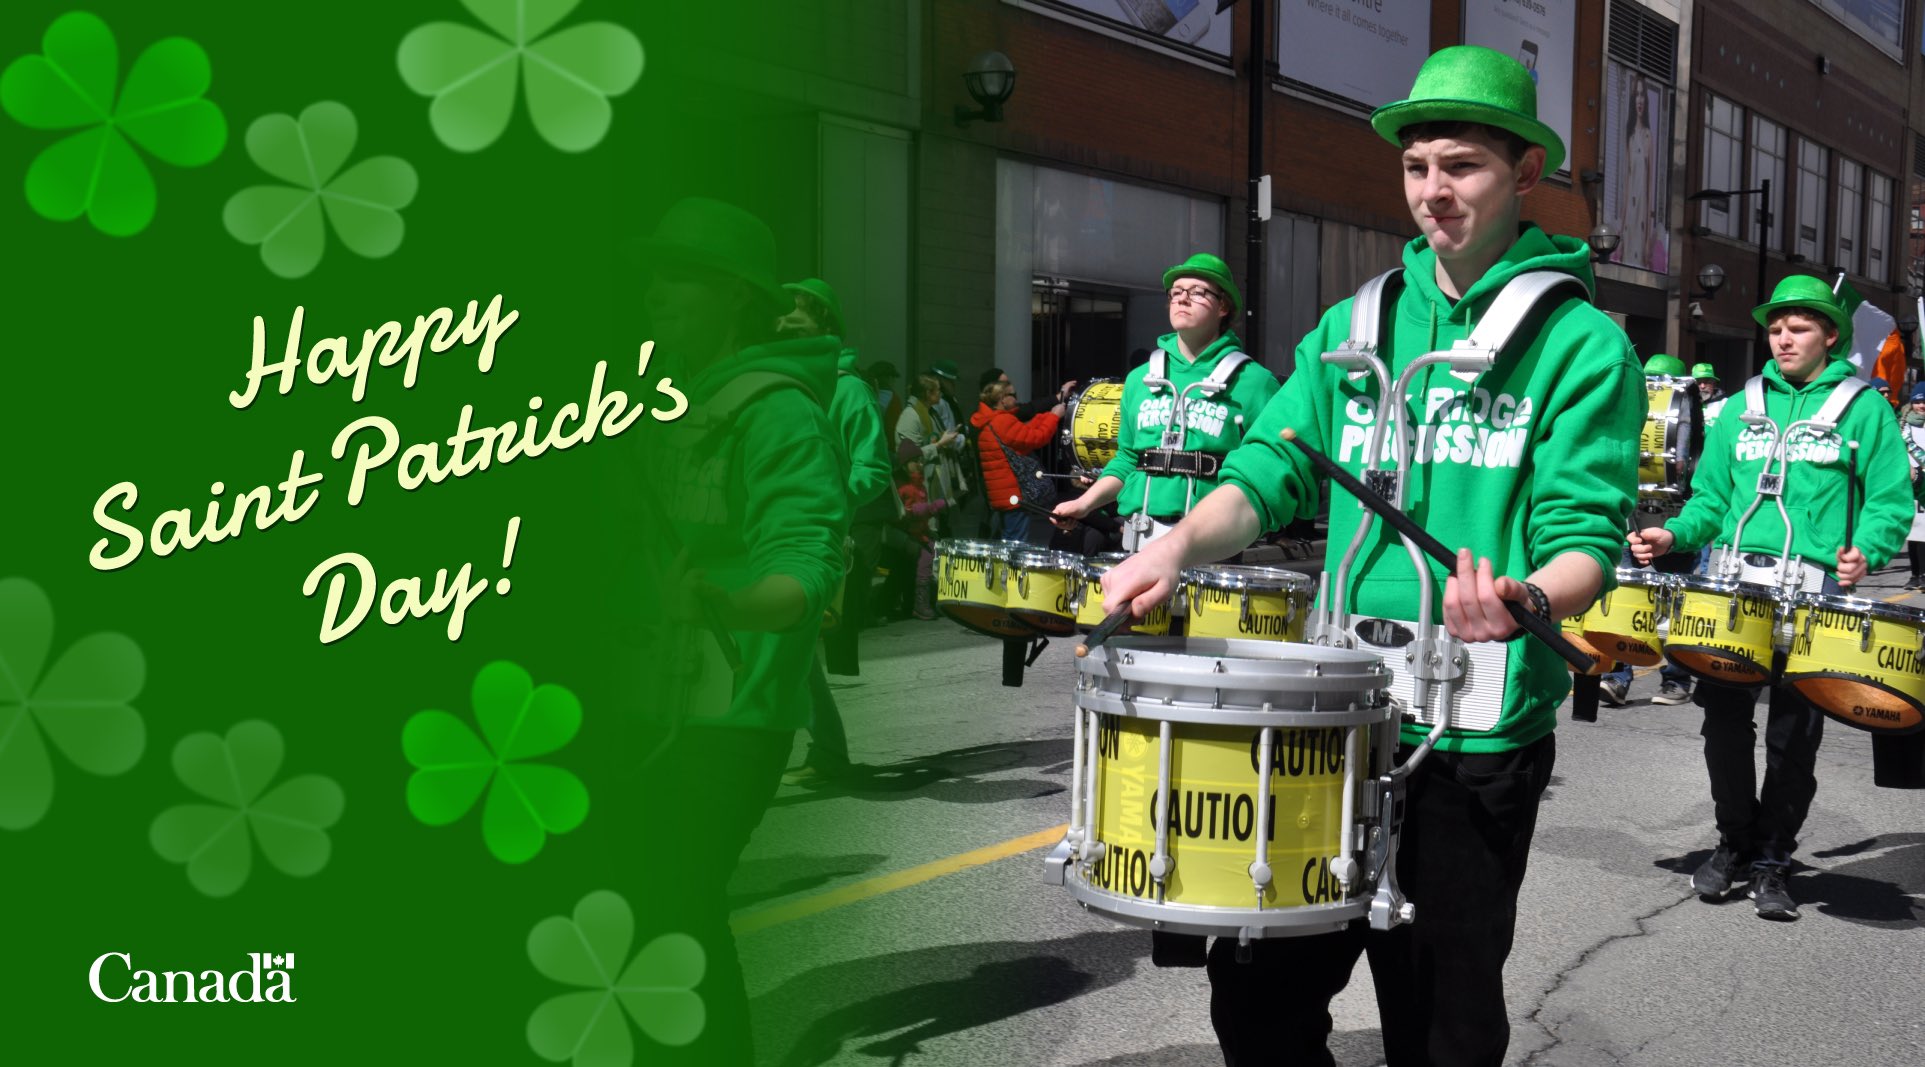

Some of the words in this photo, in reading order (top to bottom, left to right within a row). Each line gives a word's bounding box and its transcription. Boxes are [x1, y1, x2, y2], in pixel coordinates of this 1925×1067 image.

[1653, 418, 1666, 449] AUTION
[1239, 612, 1289, 636] CAUTION
[1372, 620, 1393, 645] M
[1878, 645, 1925, 676] CAUTIO
[1865, 706, 1901, 722] YAMAHA
[1250, 727, 1345, 777] CAUTIO
[1119, 764, 1147, 846] YAMA
[1092, 841, 1165, 904] AUTIO
